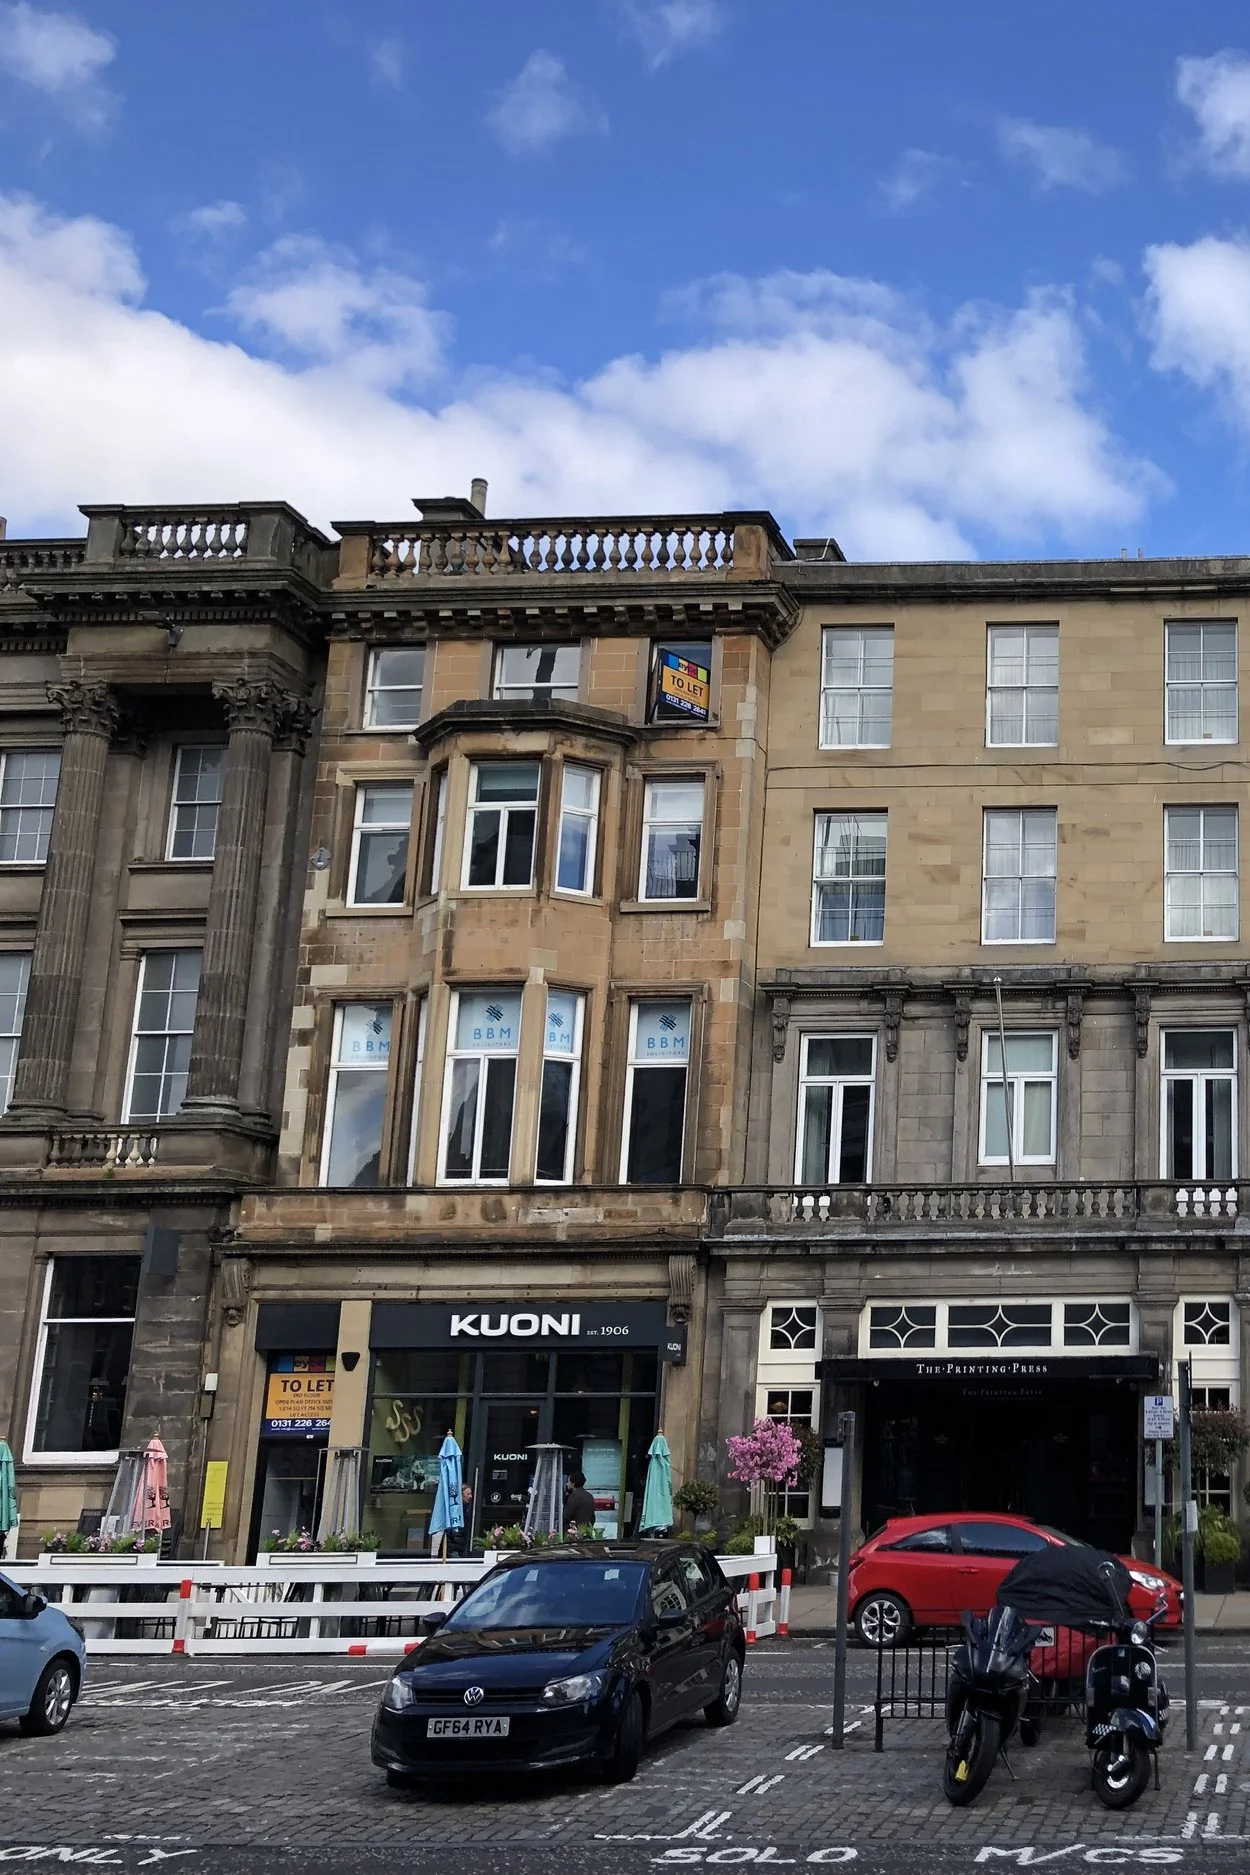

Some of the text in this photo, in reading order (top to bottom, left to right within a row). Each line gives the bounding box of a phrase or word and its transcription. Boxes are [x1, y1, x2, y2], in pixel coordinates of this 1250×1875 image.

[671, 674, 684, 689] TO
[687, 681, 704, 697] LET
[666, 693, 679, 704] 0131
[473, 1027, 511, 1039] BBM
[548, 1032, 570, 1043] BM
[352, 1040, 390, 1052] BBM
[647, 1036, 685, 1049] BBM
[450, 1313, 581, 1337] KUONI
[600, 1326, 630, 1336] 1906
[281, 1379, 335, 1393] TO LET
[271, 1419, 291, 1428] 0131
[315, 1419, 331, 1427] 264
[494, 1453, 528, 1461] KUONI
[433, 1719, 502, 1735] GF64 RYA
[0, 1846, 198, 1866] ONLY
[650, 1846, 858, 1864] SOLO
